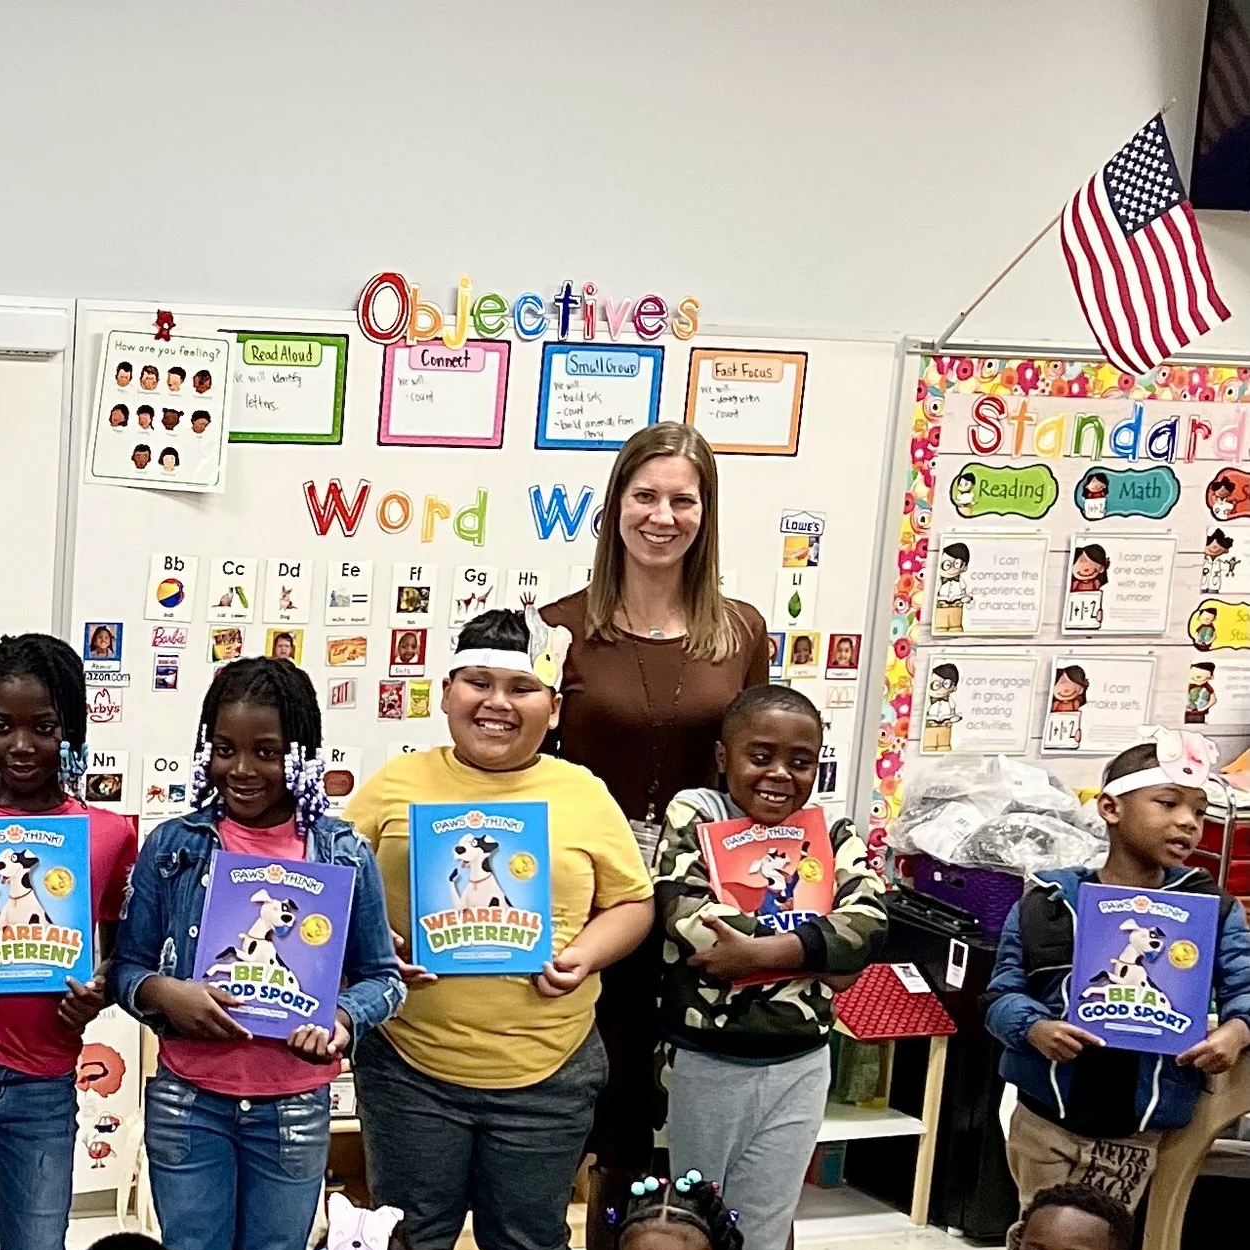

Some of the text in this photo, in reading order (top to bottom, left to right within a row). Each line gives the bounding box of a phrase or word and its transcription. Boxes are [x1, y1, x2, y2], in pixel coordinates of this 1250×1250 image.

[357, 271, 702, 349] Objectives
[115, 340, 221, 363] How are you feeling?
[251, 343, 313, 362] Read Aloud
[421, 349, 471, 368] Connect
[570, 354, 637, 374] Small Group
[715, 362, 773, 378] Fast Focus
[967, 394, 1250, 464] Standard
[978, 478, 1046, 503] Reading
[1118, 480, 1162, 498] Math
[302, 478, 489, 548] Word
[785, 518, 820, 533] LOWE'S
[164, 555, 185, 571] Bb
[998, 556, 1020, 566] can
[1124, 553, 1142, 562] can
[222, 560, 245, 576] Cc
[278, 563, 301, 577] Dd
[341, 562, 360, 577] Ee
[410, 566, 422, 581] Ff
[1113, 566, 1164, 577] one object
[464, 569, 487, 586] Gg
[518, 572, 538, 586] Hh
[971, 570, 1038, 582] compare the
[1117, 580, 1136, 588] with
[972, 587, 1036, 597] experiences
[151, 626, 187, 647] Barbie
[966, 677, 986, 685] can
[989, 677, 1031, 689] engage
[1109, 684, 1131, 694] can
[984, 692, 1015, 703] group
[971, 707, 1012, 718] reading
[331, 748, 346, 762] Rr
[822, 745, 836, 758] Zz
[92, 752, 116, 767] Nn
[154, 758, 179, 772] Oo
[433, 818, 466, 831] PAWS
[24, 832, 62, 846] THINK!
[233, 868, 265, 880] PAWS
[423, 908, 539, 931] WE ARE ALL
[2, 926, 43, 942] ARE
[46, 927, 81, 947] ALL
[429, 926, 537, 949] DIFFERENT
[234, 965, 285, 987] BE A
[259, 985, 316, 1013] SPORT
[1108, 987, 1156, 1006] BE A
[1082, 1004, 1129, 1018] GOOD
[1134, 1005, 1187, 1031] SPORT
